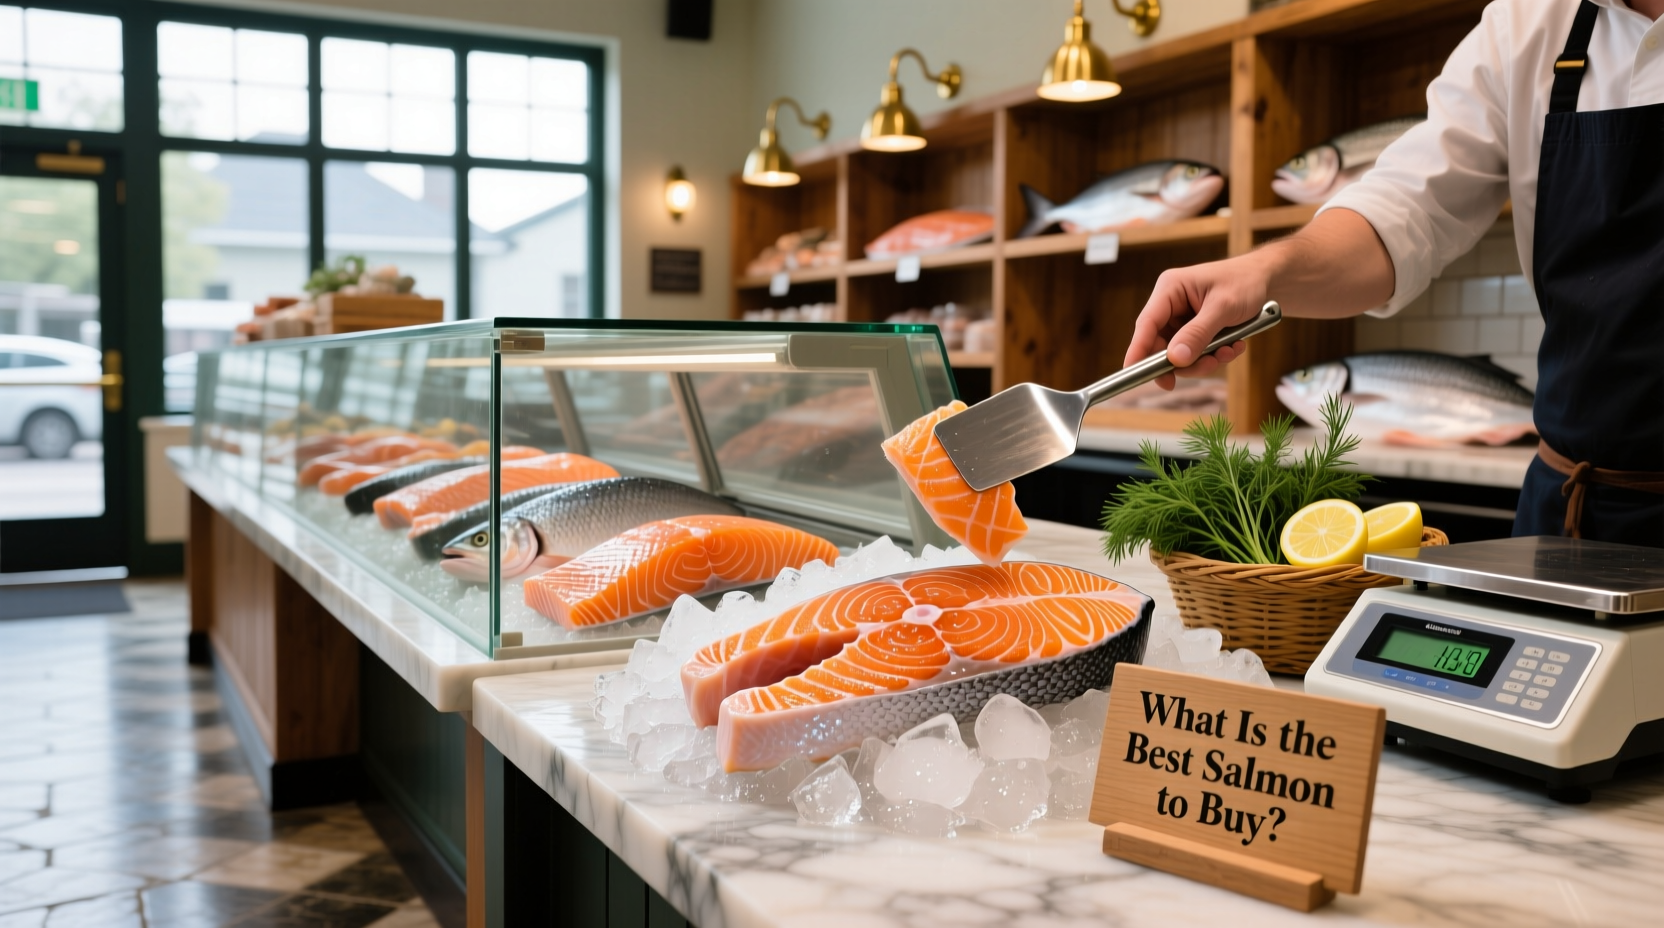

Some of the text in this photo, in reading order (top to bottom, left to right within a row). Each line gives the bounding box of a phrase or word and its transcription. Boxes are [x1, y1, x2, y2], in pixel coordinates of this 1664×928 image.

[1140, 690, 1337, 761] What Is the
[1123, 731, 1335, 810] Best Salmon
[1157, 786, 1287, 847] to Buy?
